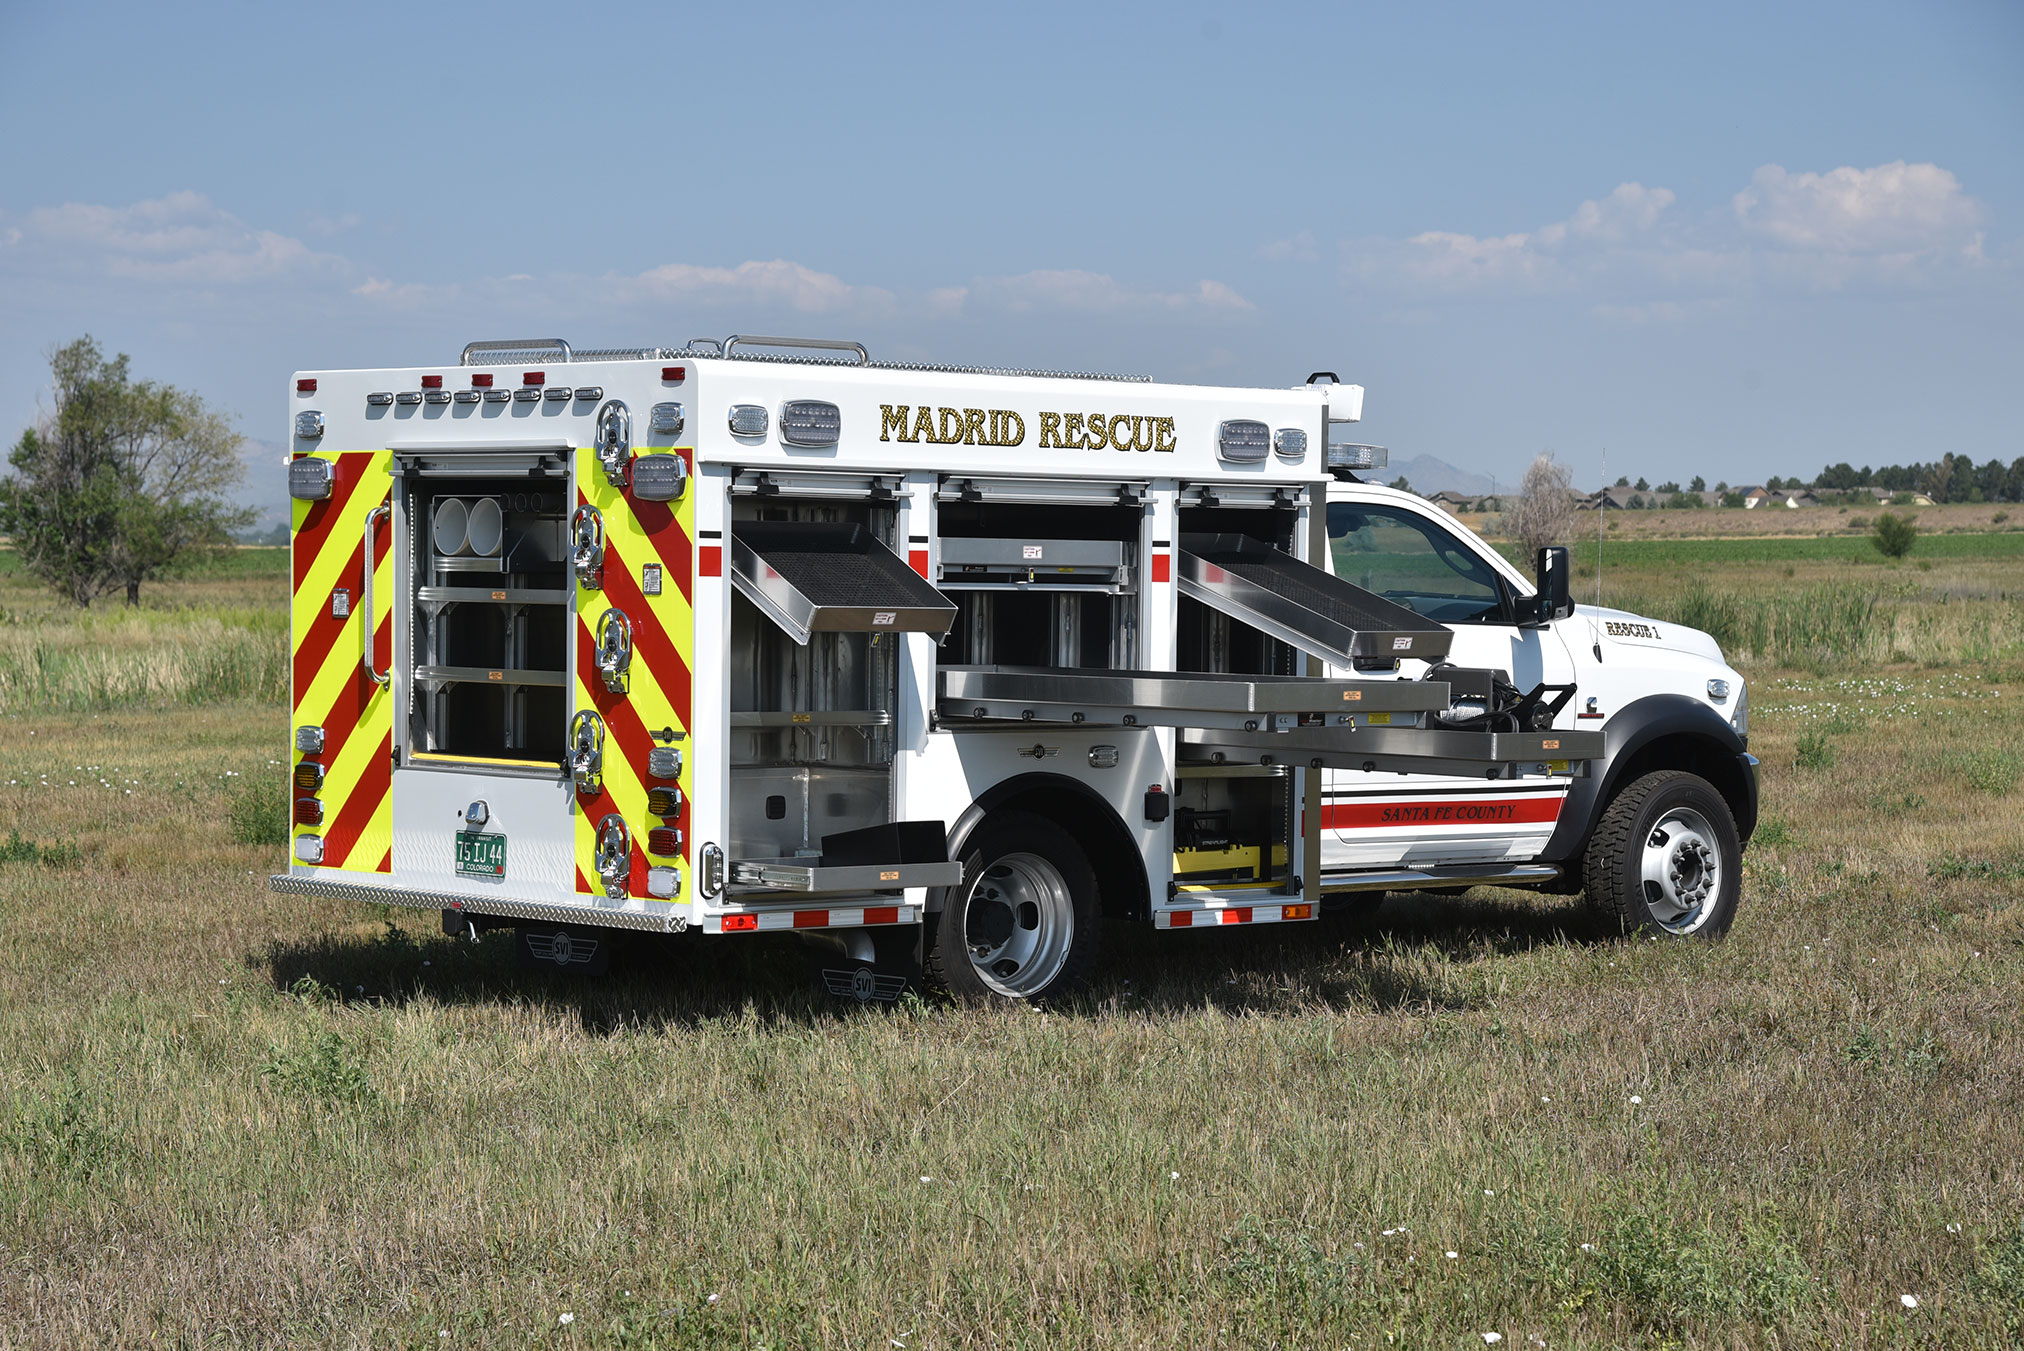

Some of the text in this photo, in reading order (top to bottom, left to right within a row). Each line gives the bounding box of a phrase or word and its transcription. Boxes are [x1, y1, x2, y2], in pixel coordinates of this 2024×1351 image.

[879, 404, 1177, 453] MADRID RESCUE
[1605, 621, 1662, 640] RESCUE 1
[1381, 804, 1517, 822] SANTA FE COUNTY
[457, 841, 471, 862] 75
[489, 844, 502, 865] 44
[466, 863, 494, 873] COLORADO
[555, 941, 569, 955] SVI
[855, 977, 871, 993] SVI
